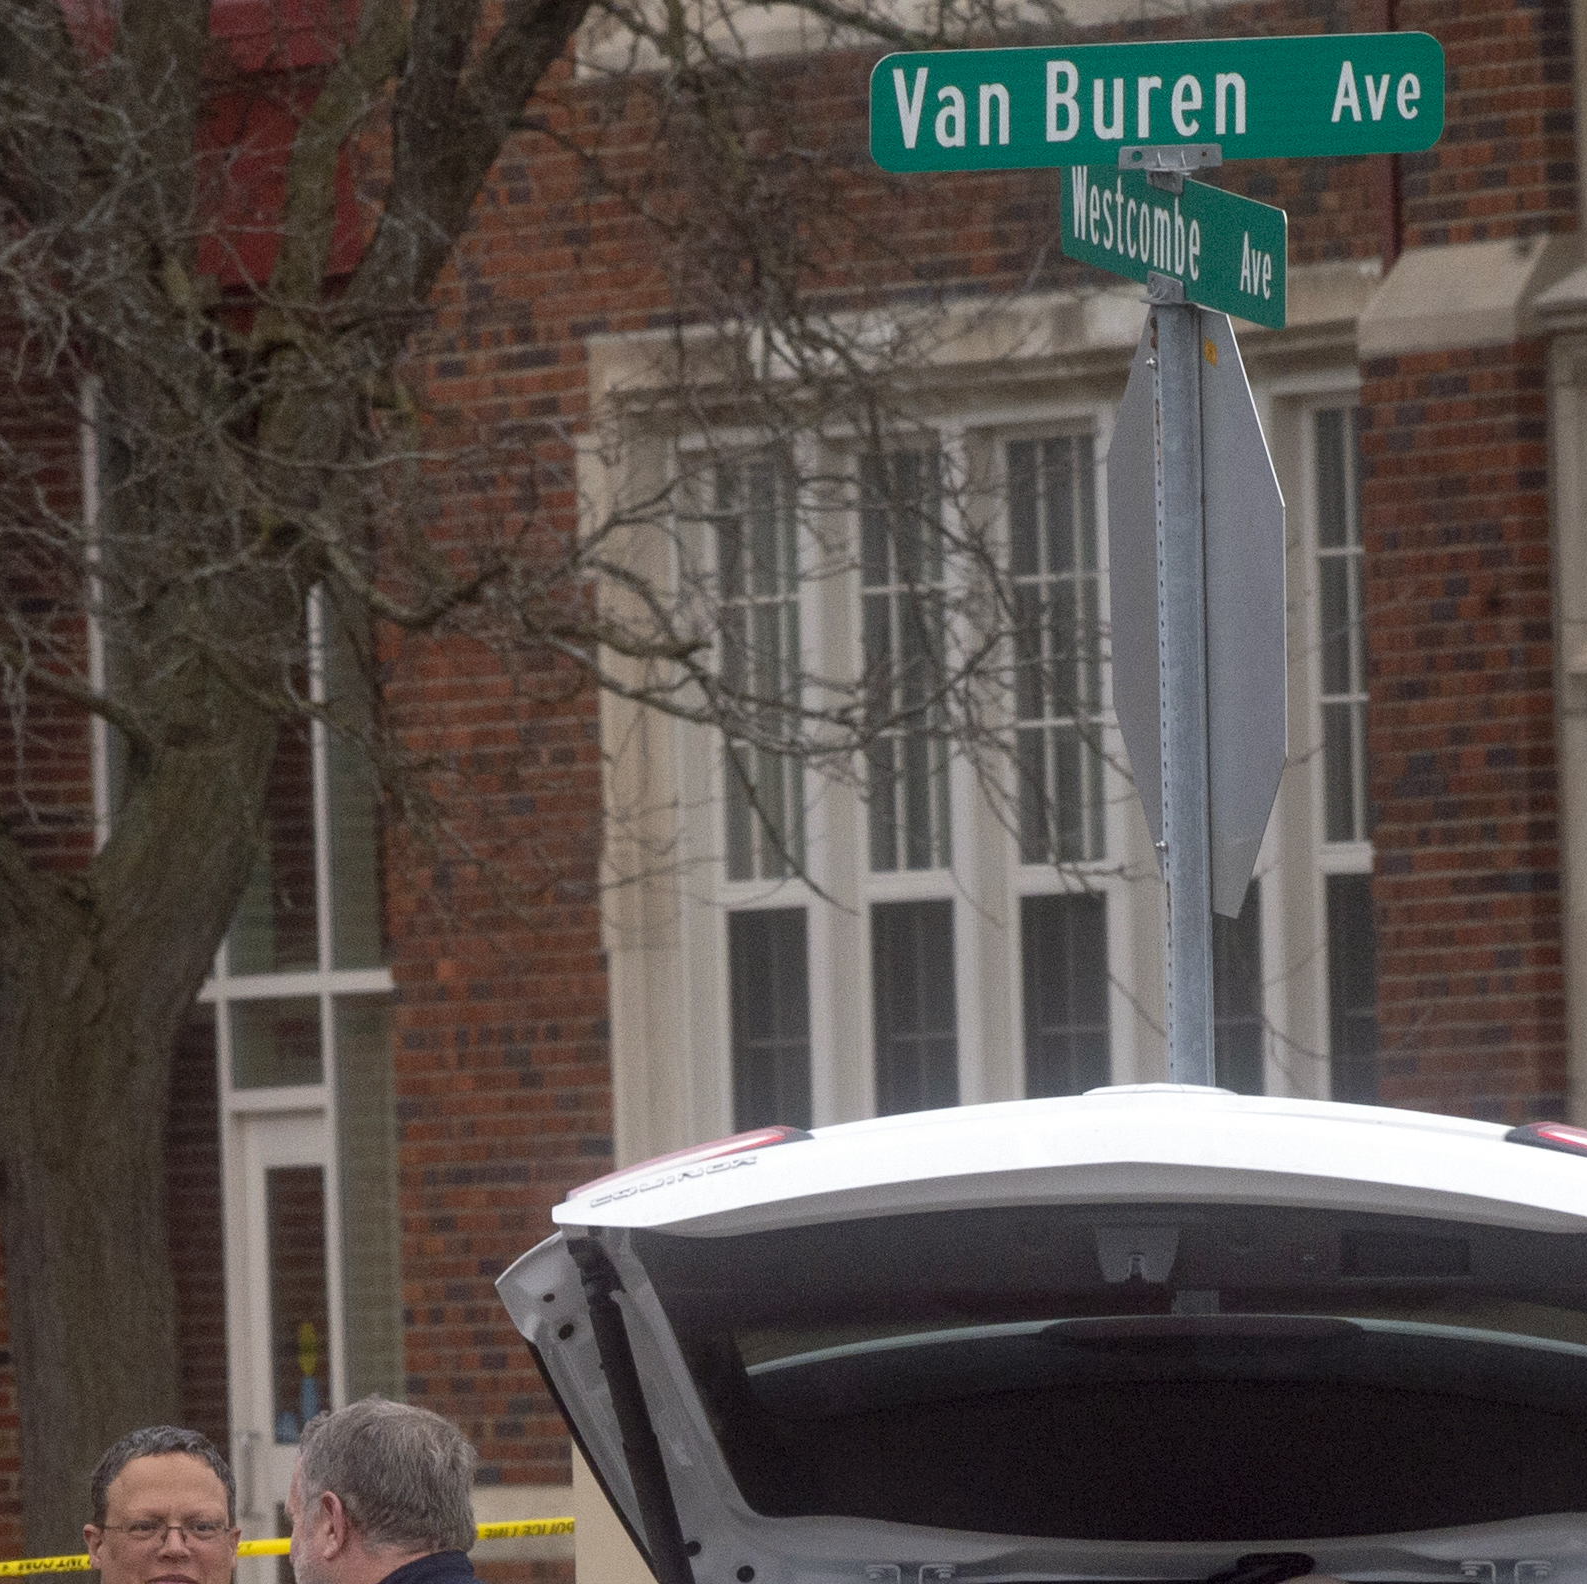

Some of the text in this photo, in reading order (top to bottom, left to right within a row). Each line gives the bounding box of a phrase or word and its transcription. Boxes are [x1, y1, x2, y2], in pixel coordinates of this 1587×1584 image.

[891, 59, 1422, 149] Van Buren Ave
[1070, 165, 1272, 300] Westcombe Ave
[589, 1155, 758, 1209] EQUINOX
